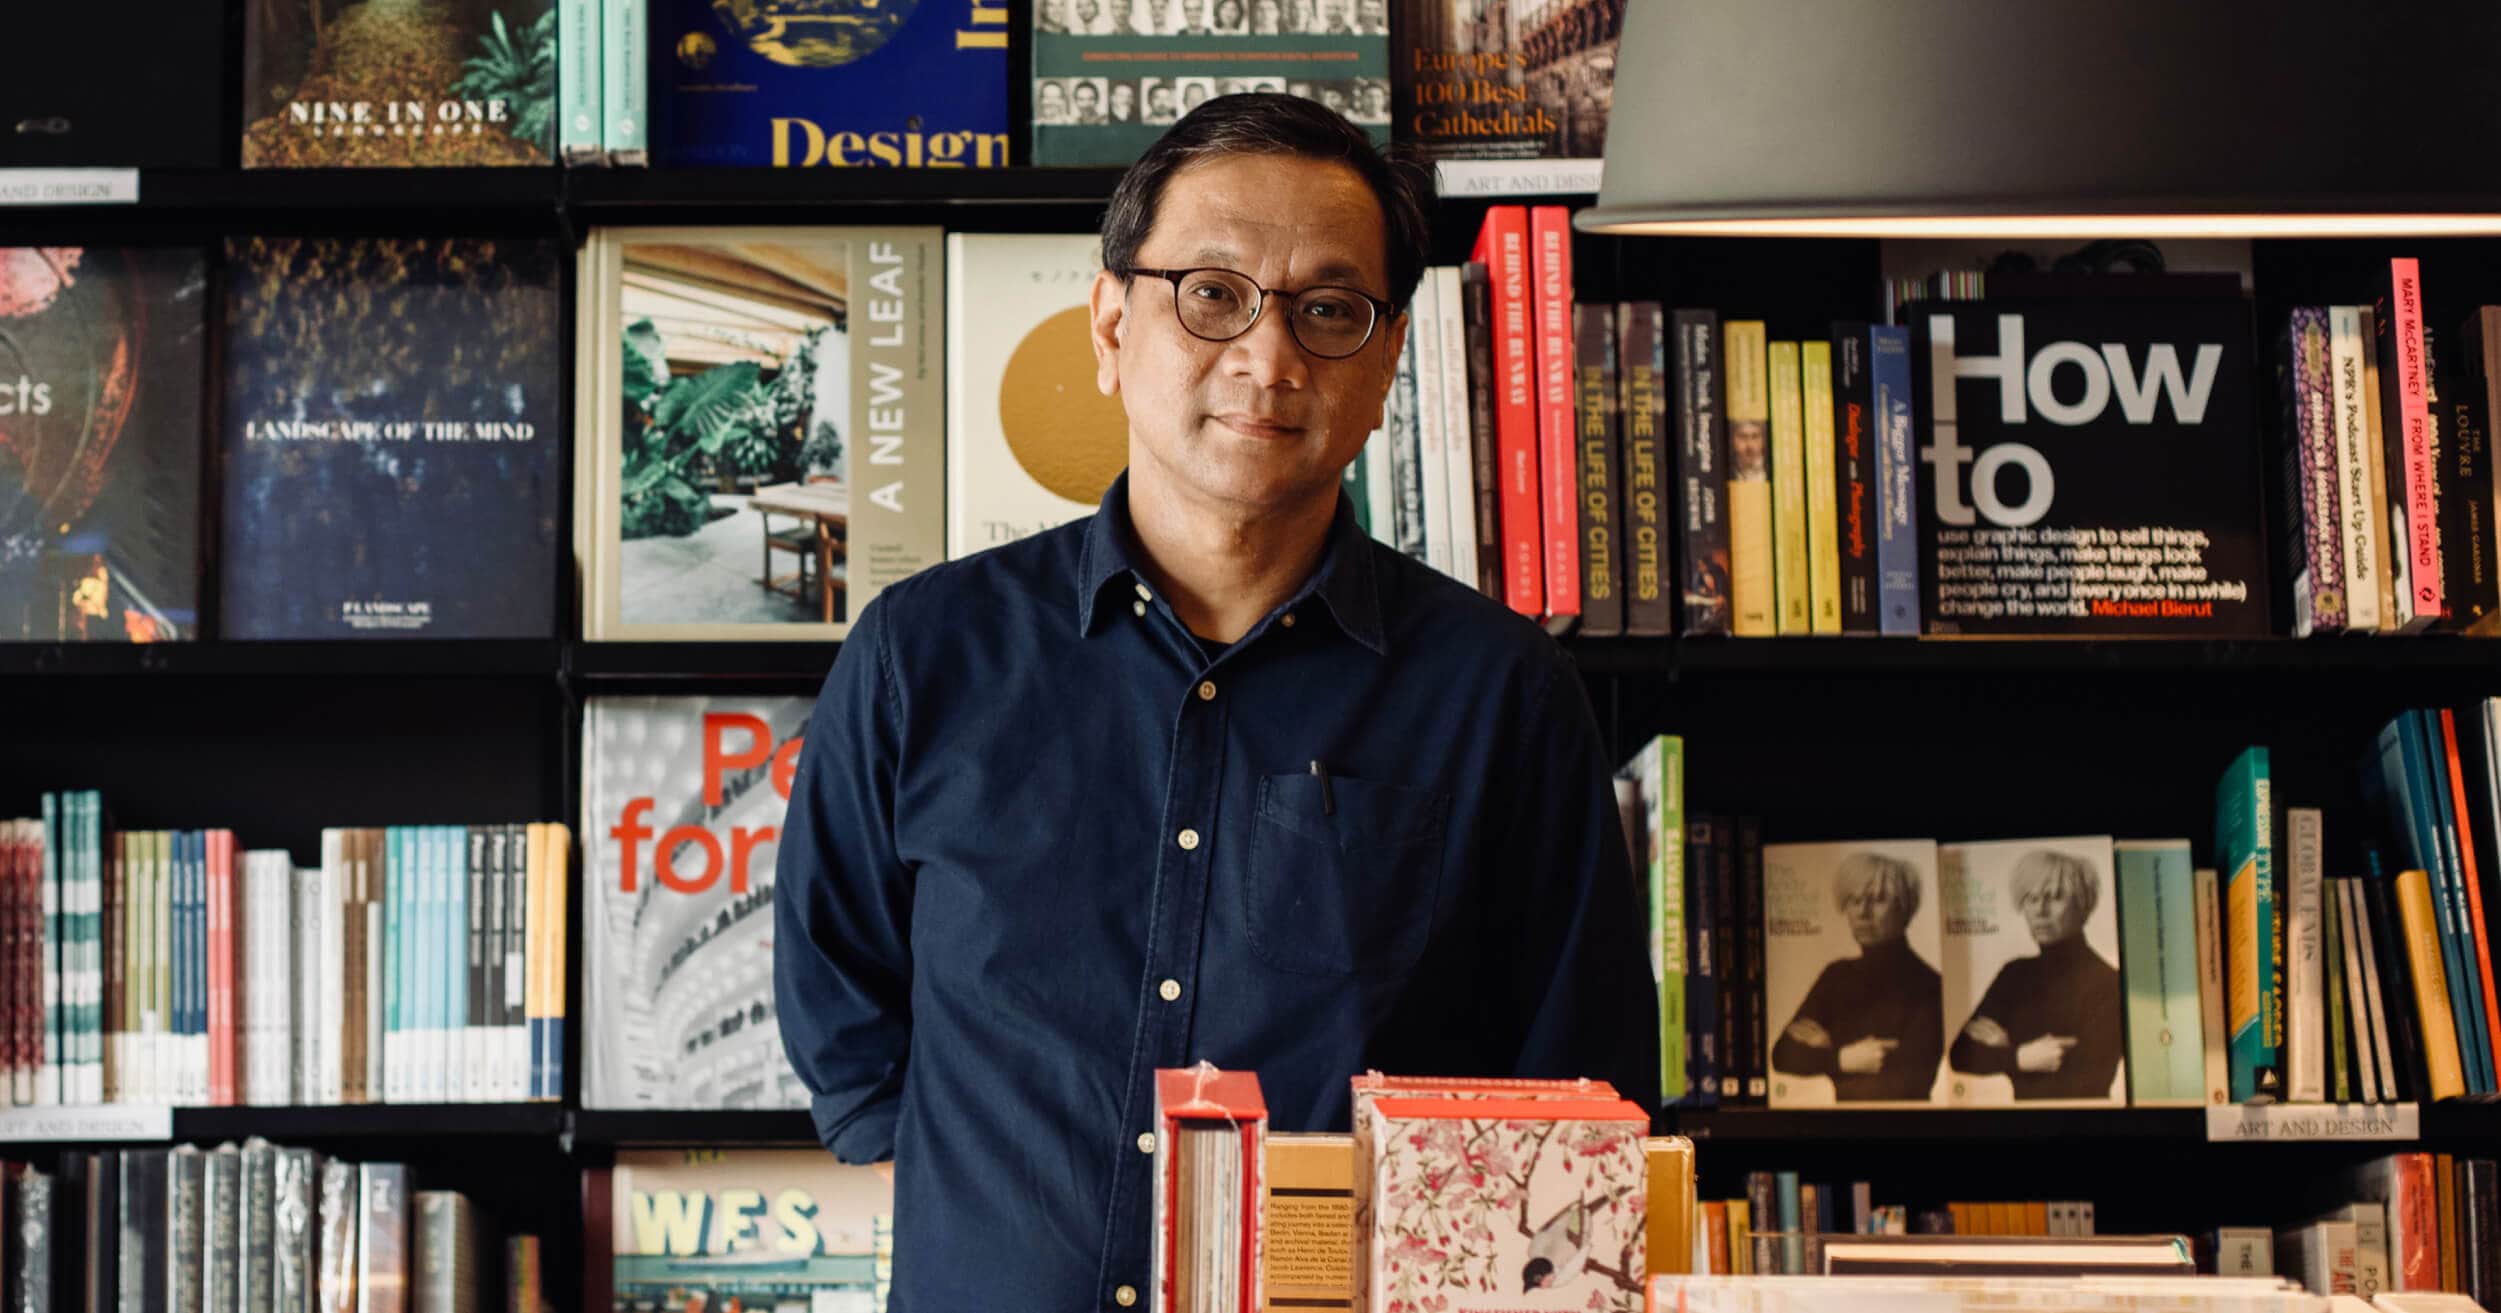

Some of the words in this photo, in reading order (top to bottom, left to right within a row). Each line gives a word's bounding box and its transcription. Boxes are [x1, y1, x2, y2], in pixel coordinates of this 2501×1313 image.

[1414, 48, 1528, 77] Europe's
[290, 101, 372, 124] NINE
[388, 101, 425, 123] IN
[437, 100, 508, 122] ONE
[1415, 80, 1467, 105] 100
[1472, 79, 1527, 105] Best
[771, 117, 1009, 168] Design
[1413, 107, 1557, 135] Cathedrals
[1465, 175, 1503, 192] ART
[1511, 175, 1548, 191] AND
[1553, 174, 1601, 190] DESI
[1504, 232, 1522, 299] BEHIND
[1543, 231, 1562, 297] BEHIND
[868, 240, 904, 347] LEAF
[1545, 300, 1563, 332] THE
[2401, 278, 2415, 315] MARY
[1506, 300, 1524, 334] THE
[1508, 337, 1527, 406] RUNWAY
[1547, 336, 1566, 404] RUNWAY
[1584, 365, 1603, 391] IN
[1631, 365, 1653, 391] IN
[1929, 313, 2224, 427] How
[2343, 356, 2357, 402] NPR's
[2404, 318, 2421, 398] McCARTNEY
[246, 421, 382, 442] LANDSCAPE
[384, 421, 416, 441] OF
[422, 421, 471, 441] THE
[475, 420, 535, 441] MIND
[868, 362, 904, 466] NEW
[1585, 392, 1606, 437] THE
[1633, 392, 1655, 437] THE
[2345, 404, 2361, 465] Podcast
[2411, 417, 2424, 456] FROM
[2456, 404, 2473, 478] LOUVRE
[1586, 440, 1608, 489] LIFE
[1634, 440, 1657, 489] LIFE
[1921, 428, 2056, 528] to
[2414, 460, 2428, 511] WHERE
[868, 481, 904, 513] A
[1588, 491, 1609, 525] OF
[1636, 491, 1658, 525] OF
[2349, 467, 2363, 508] Start
[1937, 531, 1969, 544] use
[1972, 527, 2038, 548] graphic
[2040, 527, 2097, 547] design
[2100, 529, 2118, 544] to
[2120, 527, 2150, 544] sell
[2151, 527, 2210, 548] things,
[2351, 509, 2366, 532] Up
[2469, 500, 2480, 533] JAMES
[1589, 526, 1612, 600] CITIES
[1637, 526, 1660, 601] CITIES
[1938, 547, 1999, 565] explain
[2060, 547, 2107, 562] make
[2108, 547, 2162, 565] things
[2164, 547, 2202, 562] look
[2354, 535, 2369, 582] Guide
[2417, 522, 2432, 568] STAND
[1939, 582, 1998, 601] people
[2035, 581, 2065, 597] and
[2122, 584, 2164, 598] once
[2166, 582, 2184, 598] in
[2185, 586, 2198, 598] a
[1998, 564, 2045, 580] make
[2046, 566, 2105, 584] people
[2158, 564, 2207, 580] make
[1939, 600, 2004, 618] change
[2006, 600, 2036, 616] the
[2092, 600, 2159, 616] Michael
[2160, 600, 2213, 616] Bierut
[1665, 828, 1681, 911] SALVAGE
[2256, 849, 2274, 904] TYPE
[2299, 814, 2318, 898] GLOBAL
[1667, 915, 1682, 973] STYLE
[2300, 902, 2317, 963] ENDS
[2235, 1119, 2273, 1137] ART
[2280, 1119, 2320, 1136] AND
[2325, 1118, 2394, 1135] DESIGN
[630, 1188, 824, 1258] WES
[2240, 1243, 2253, 1272] THE
[2364, 1266, 2379, 1301] PO
